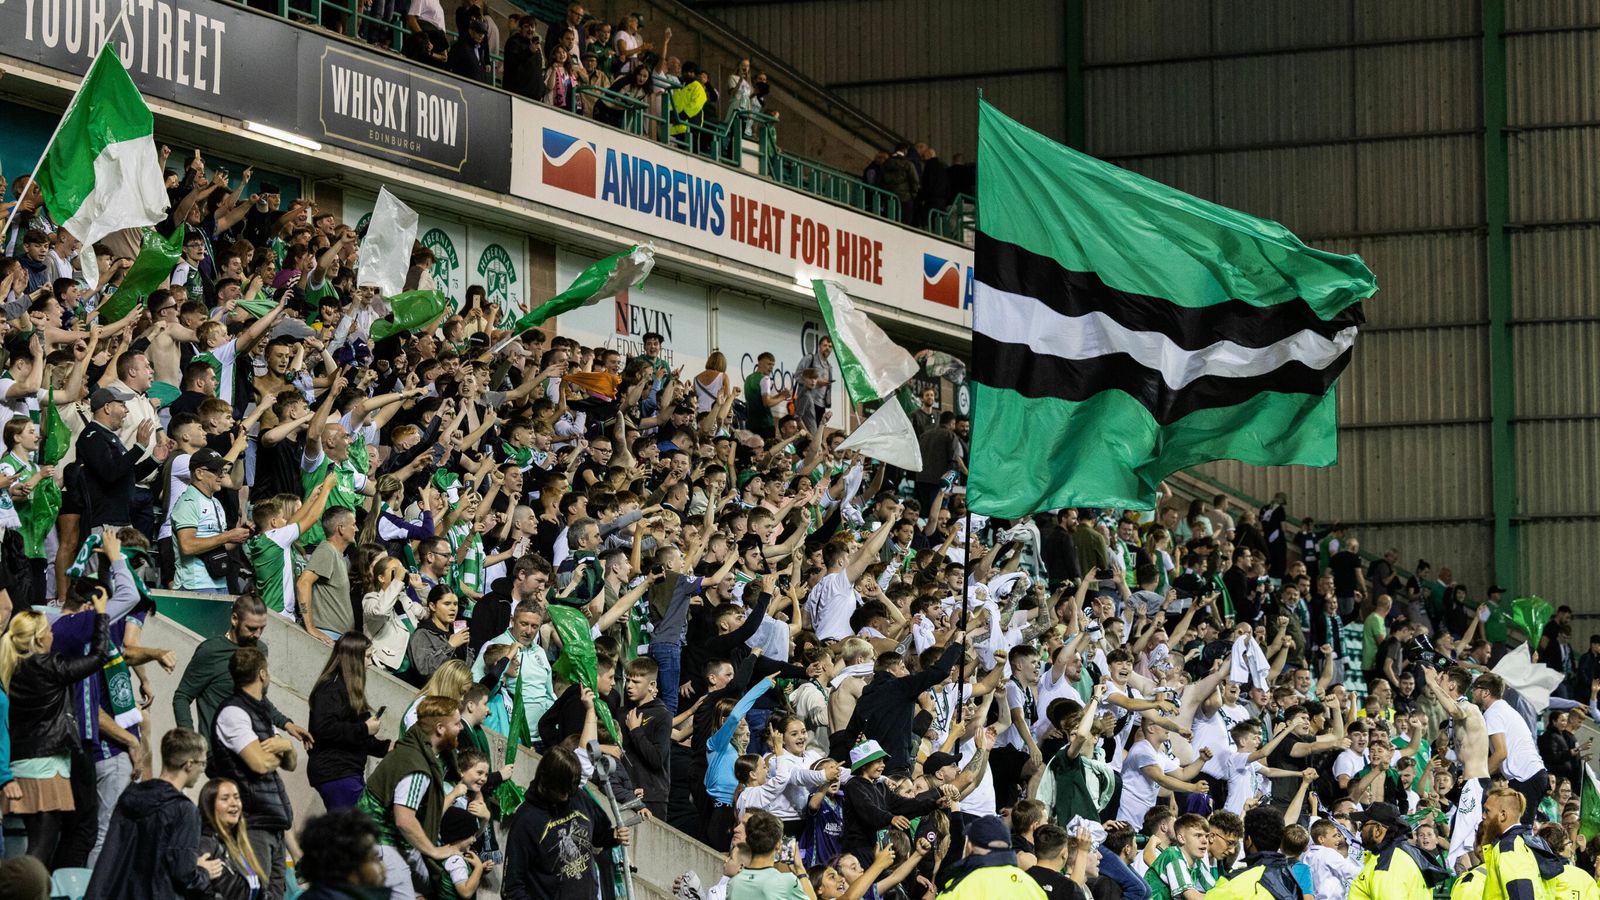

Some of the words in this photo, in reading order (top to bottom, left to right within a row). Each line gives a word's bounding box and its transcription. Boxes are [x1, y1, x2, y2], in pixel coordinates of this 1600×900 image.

[25, 0, 106, 58] YOUR
[119, 0, 226, 95] STREET
[331, 64, 410, 133] WHISKY
[417, 90, 459, 148] ROW
[369, 129, 421, 152] EDINBURGH
[601, 147, 726, 237] ANDREWS
[730, 193, 786, 255] HEAT
[790, 214, 831, 271] FOR
[836, 228, 883, 286] HIRE
[422, 232, 457, 264] IBERNIAN
[480, 246, 514, 278] HIBERNIAN
[615, 300, 673, 344] NEVIN
